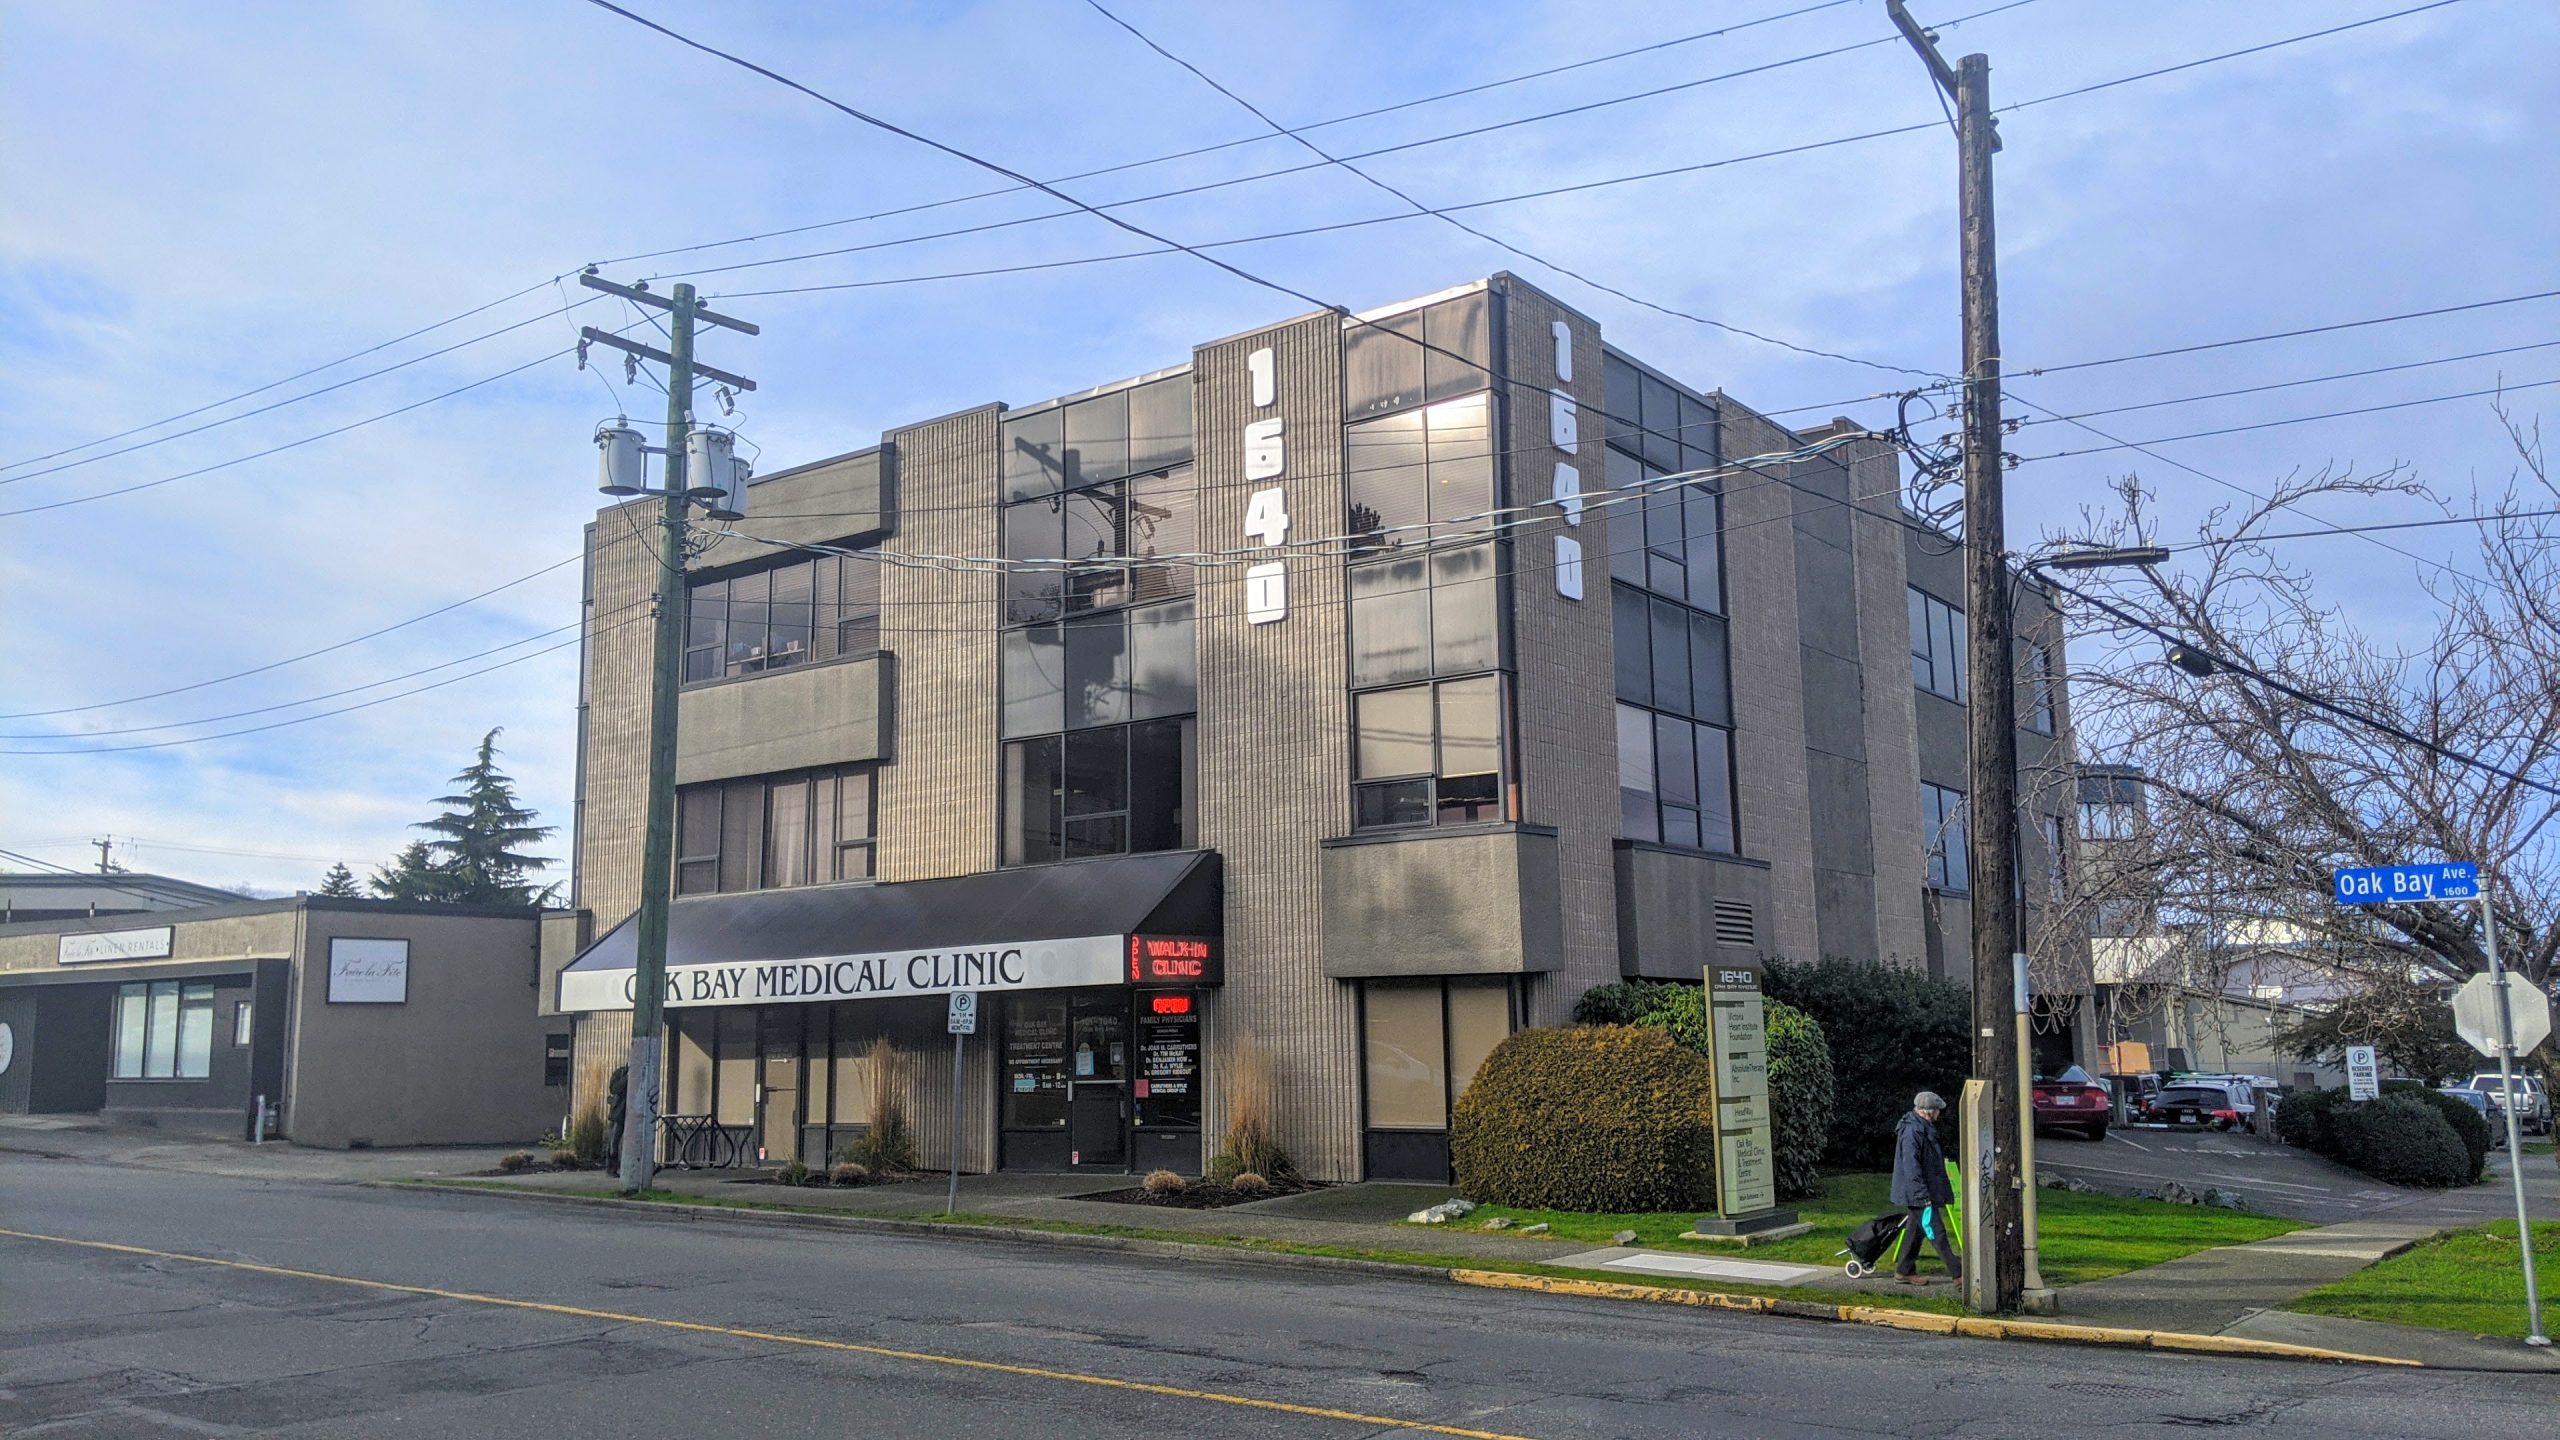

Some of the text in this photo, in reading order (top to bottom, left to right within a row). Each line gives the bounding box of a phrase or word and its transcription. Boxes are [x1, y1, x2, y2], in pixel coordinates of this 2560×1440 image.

[2340, 867, 2471, 897] Oak Bay Ave.
[2444, 886, 2468, 896] 1600
[128, 940, 165, 953] RENTALS
[1146, 940, 1207, 957] WALK-IN
[1131, 936, 1140, 980] OPEN
[691, 967, 747, 1001] BAY
[755, 958, 897, 998] MEDICAL
[907, 949, 1025, 989] CLINIC
[1152, 960, 1202, 976] CLINIC
[1719, 970, 1752, 984] 1640
